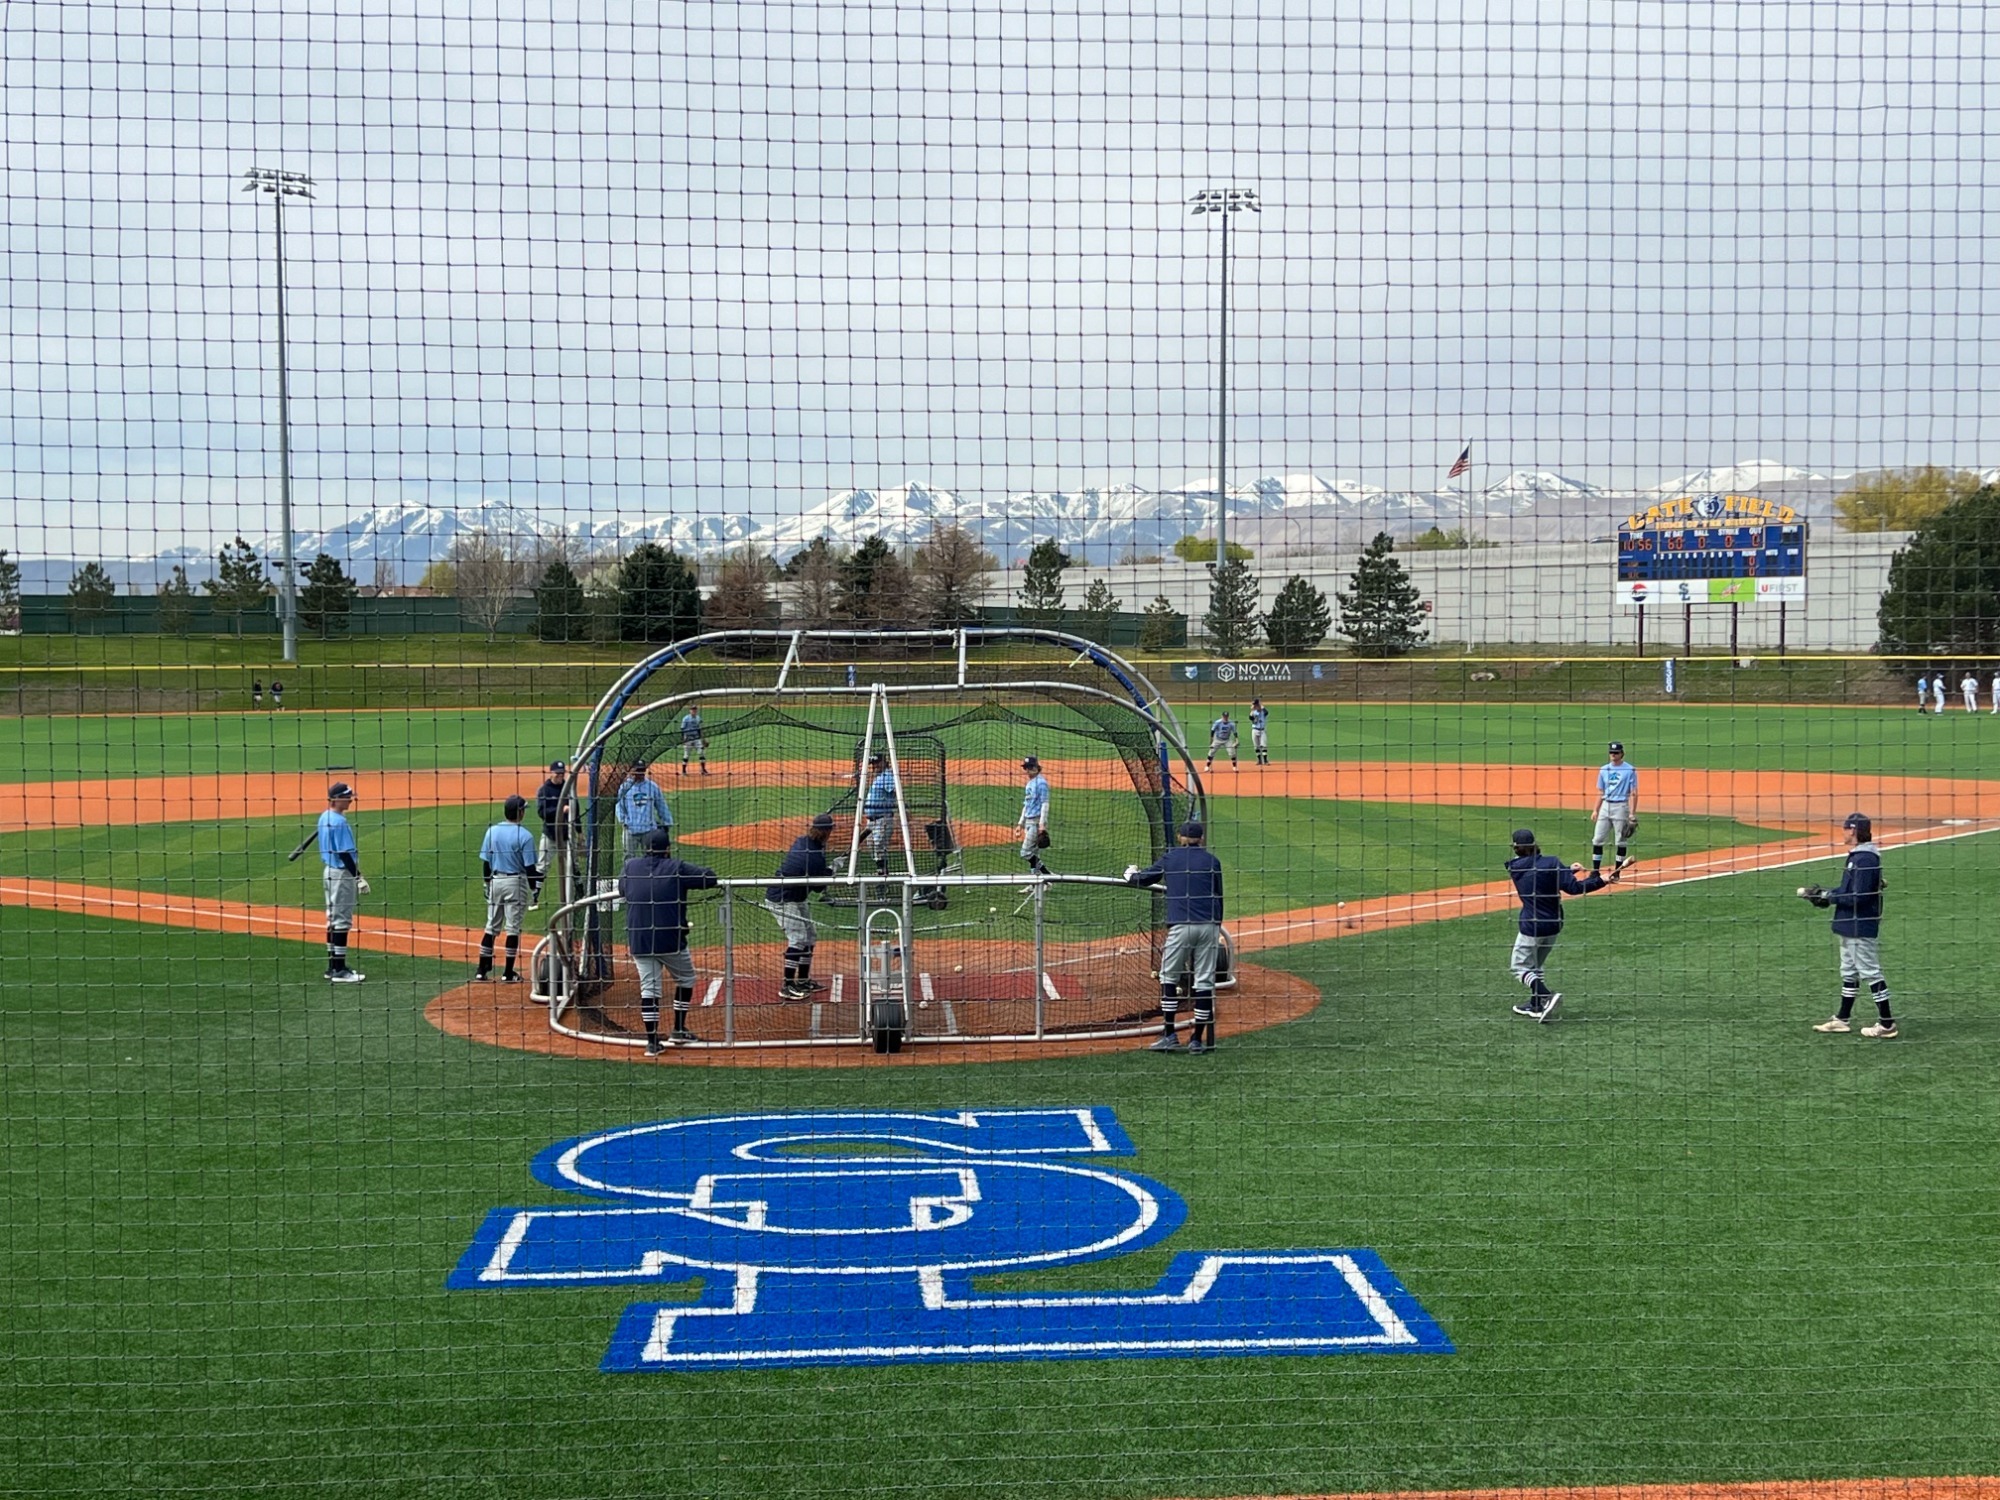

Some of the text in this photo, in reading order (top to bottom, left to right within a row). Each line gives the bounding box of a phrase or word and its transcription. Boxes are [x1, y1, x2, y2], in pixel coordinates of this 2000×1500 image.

[1628, 495, 1796, 530] CATE FIELD
[1694, 529, 1709, 537] BALL
[1749, 527, 1762, 535] OUT
[1667, 536, 1683, 550] 60
[1698, 536, 1706, 549] 0
[1725, 535, 1733, 548] 0
[1749, 556, 1755, 566] 0
[1239, 663, 1291, 675] NOVVA
